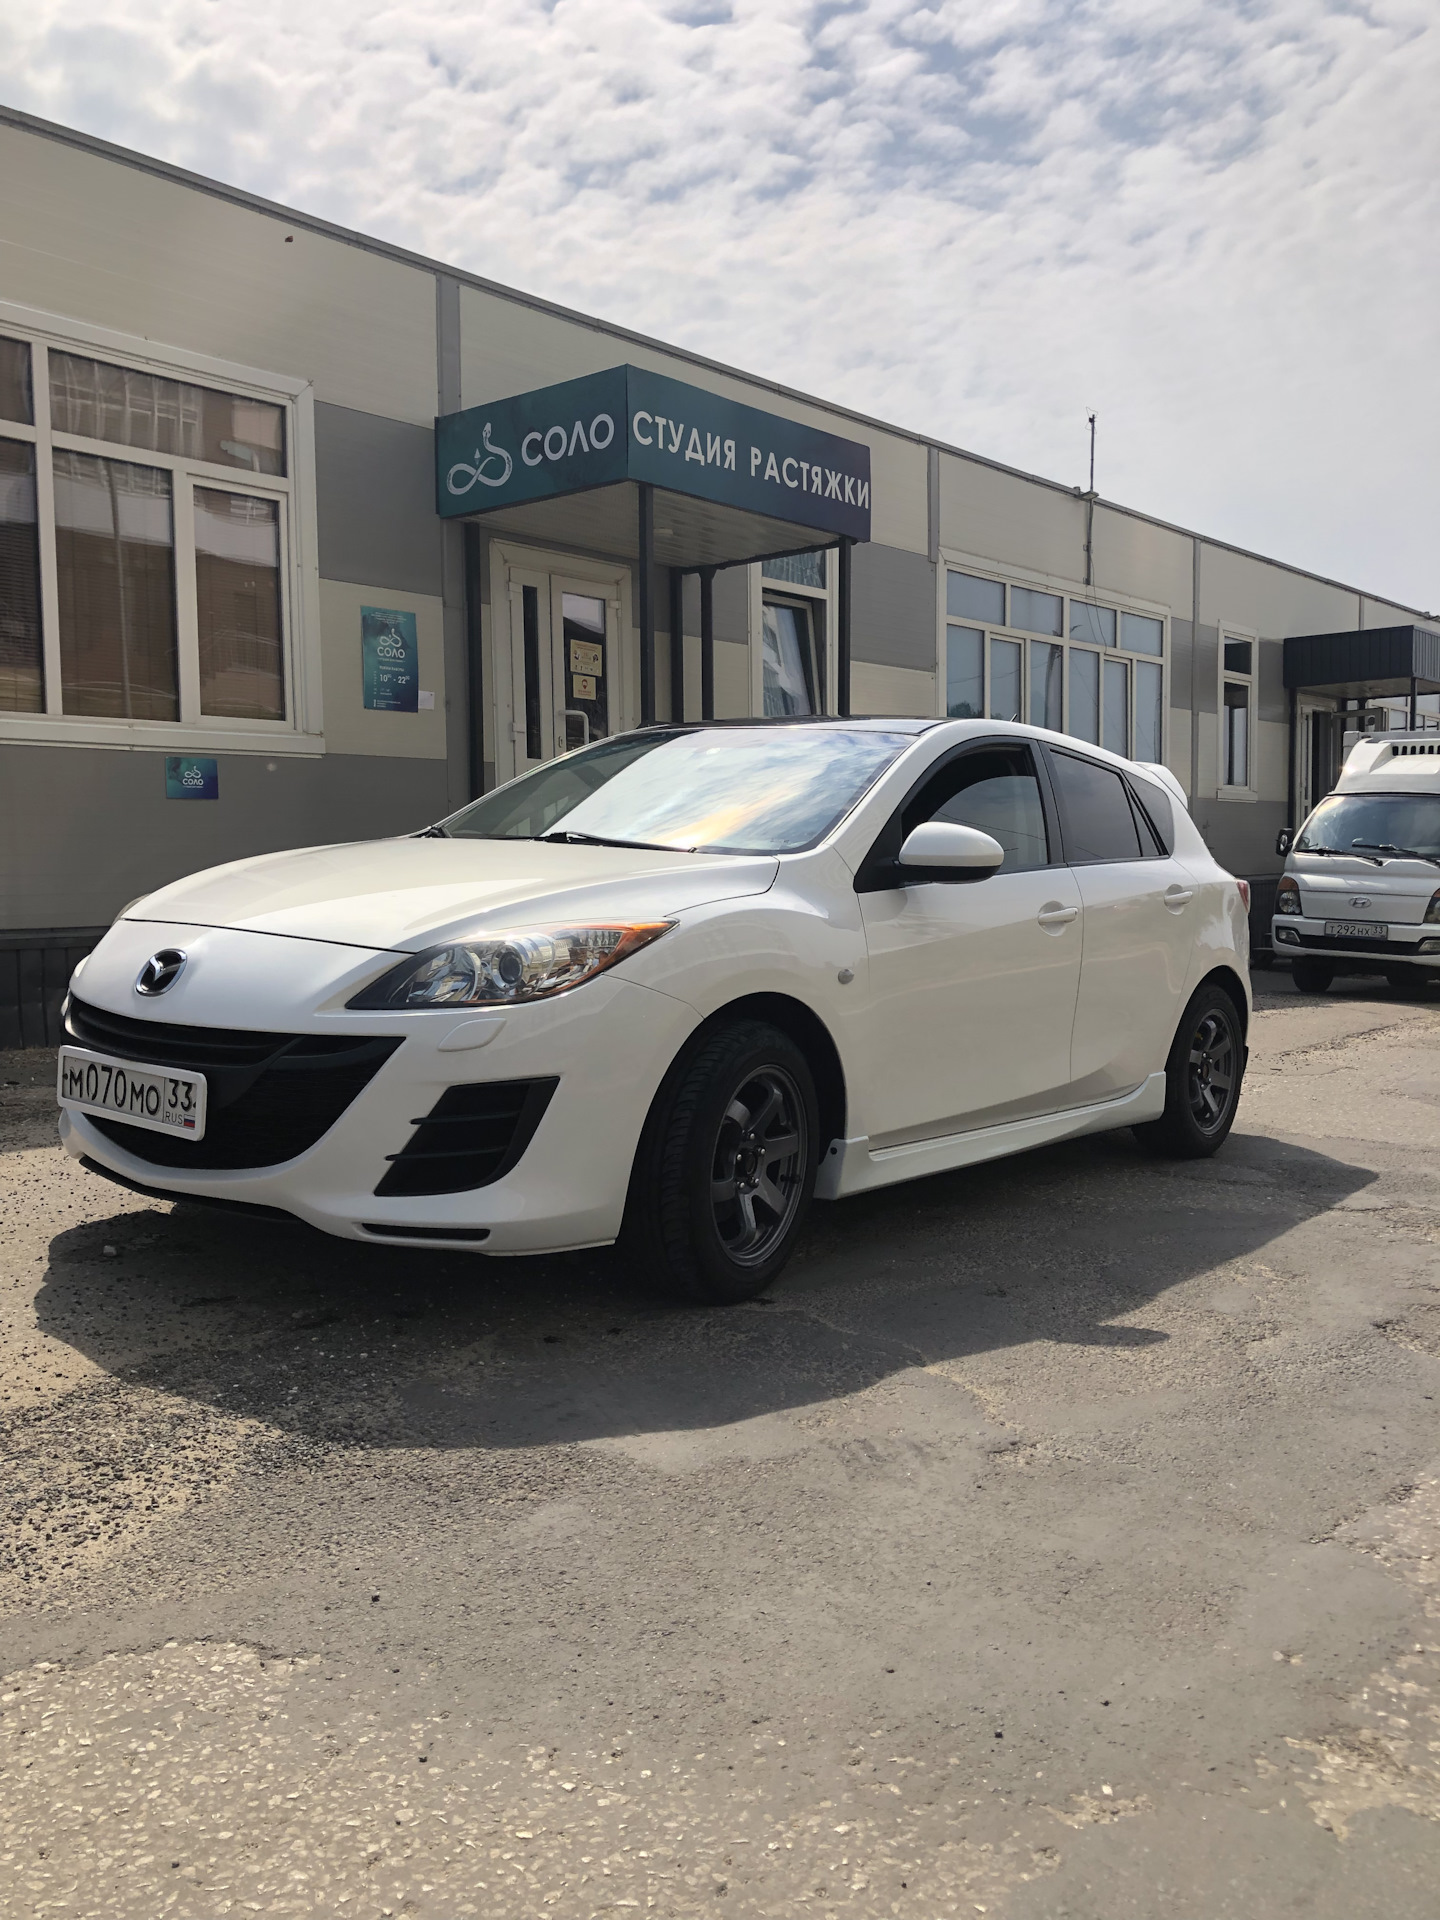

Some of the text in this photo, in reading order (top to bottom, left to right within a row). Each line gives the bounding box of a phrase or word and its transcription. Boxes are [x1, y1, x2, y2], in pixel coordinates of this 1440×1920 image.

[521, 413, 615, 467] СОЛО
[632, 411, 870, 510] СТУДИЯ РАСТЯЖКИ
[377, 647, 405, 658] СОЛО
[165, 1111, 183, 1125] RUS
